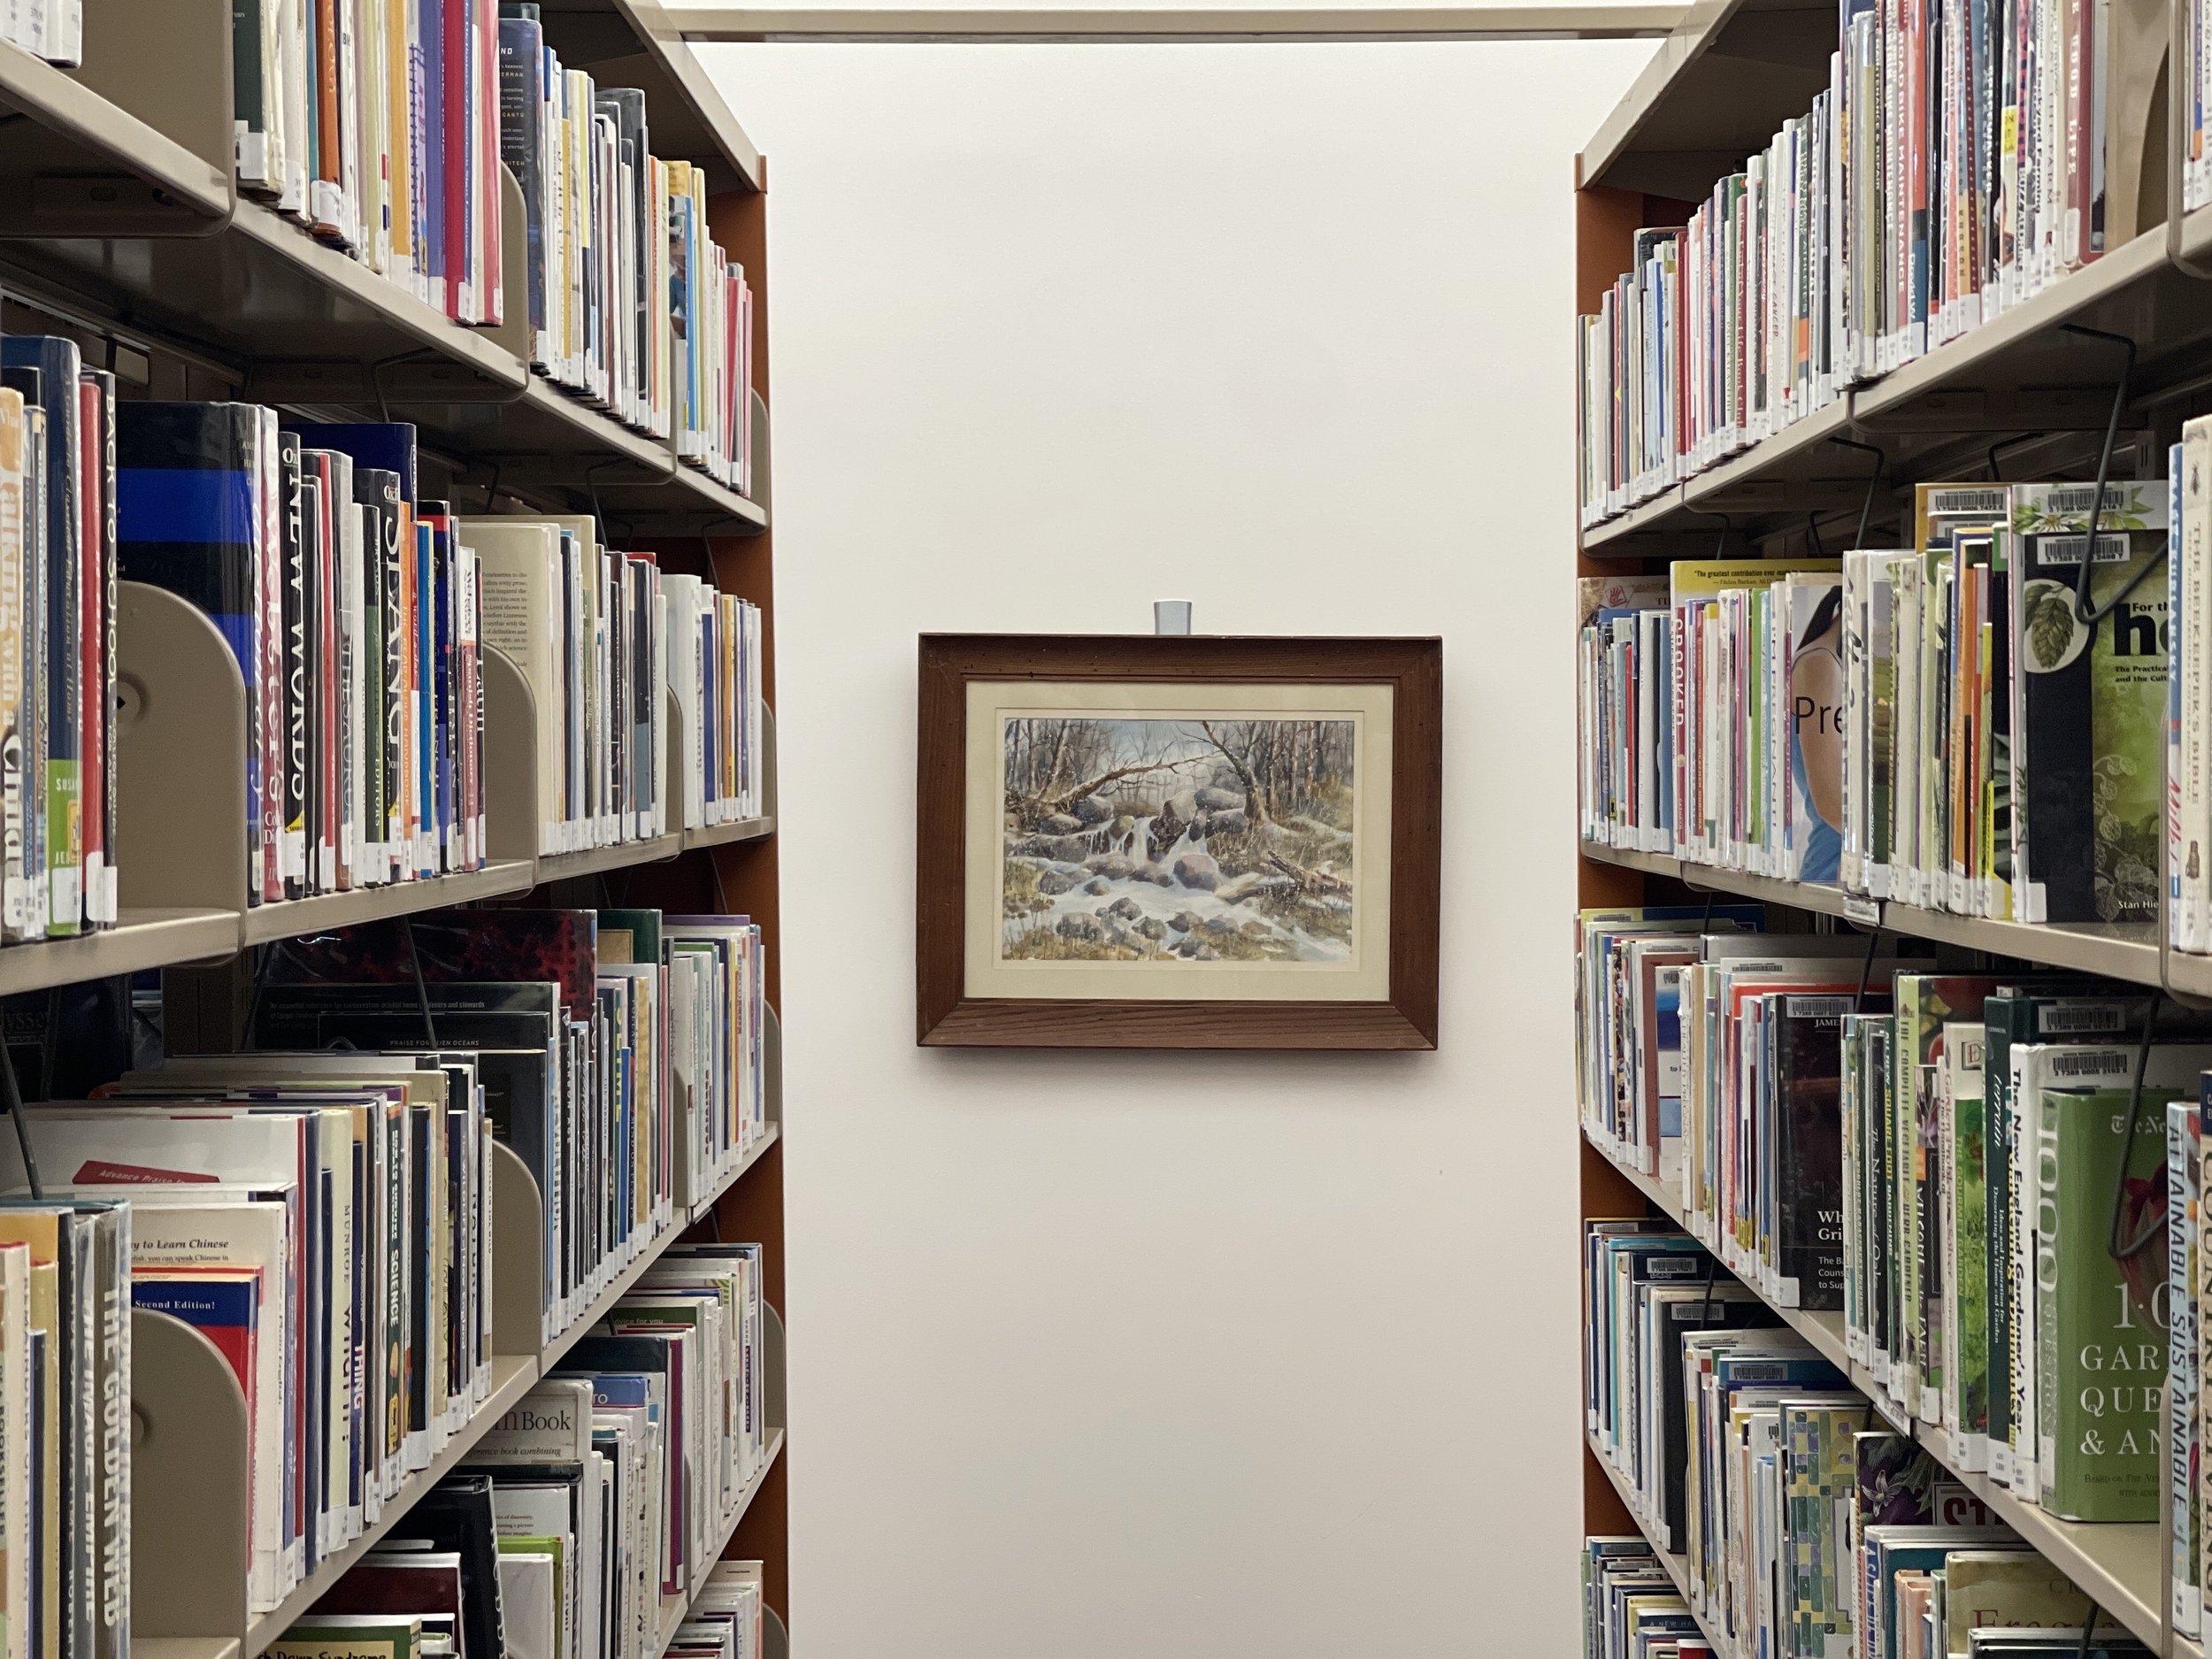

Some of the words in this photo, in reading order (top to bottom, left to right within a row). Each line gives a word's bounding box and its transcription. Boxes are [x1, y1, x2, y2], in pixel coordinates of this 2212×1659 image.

[106, 395, 115, 484] BACK
[107, 498, 115, 543] TO
[1708, 570, 1730, 579] greatest
[1731, 569, 1763, 578] contribution
[107, 557, 116, 693] SCHOOL
[384, 516, 403, 746] SLANG
[2132, 603, 2153, 612] For
[2169, 549, 2178, 683] KURLANSKY
[2192, 580, 2200, 733] BEEKEEPER'S
[291, 622, 304, 802] WORDS
[2118, 900, 2139, 910] Stan
[1814, 1018, 1841, 1028] JAME
[1901, 1048, 1909, 1111] COMPLETE
[2012, 1068, 2022, 1107] The
[1993, 1073, 2003, 1155] terrain
[2013, 1115, 2022, 1164] New
[98, 1168, 139, 1181] Advance
[1901, 1119, 1910, 1184] VEGETABLE
[1817, 1210, 1844, 1224] Wh
[1956, 1167, 1964, 1233] GOURMET
[2014, 1171, 2024, 1256] England
[2169, 1125, 2186, 1301] ATTAINABLE
[142, 1239, 154, 1248] to
[157, 1239, 186, 1249] Learn
[188, 1238, 229, 1248] Chinese
[1817, 1228, 1844, 1240] Gri
[390, 1248, 399, 1328] SCIENCE
[1903, 1240, 1912, 1302] GARDENER
[83, 1298, 94, 1362] THE
[104, 1288, 119, 1363] THE
[134, 1300, 171, 1310] Second
[174, 1301, 216, 1310] Edition!
[2015, 1262, 2025, 1379] Gardener's
[353, 1341, 364, 1410] THING
[2080, 1344, 2170, 1371] GAR
[83, 1368, 95, 1477] IMAGE
[521, 1409, 571, 1432] Book
[2016, 1386, 2025, 1435] Year
[2079, 1386, 2162, 1417] QUE
[2171, 1311, 2187, 1512] SUSTAINABLE
[104, 1371, 119, 1531] GOLDEN
[500, 1447, 518, 1456] book
[519, 1447, 562, 1457] combining
[2079, 1429, 2106, 1455] &
[85, 1492, 95, 1624] EMPIRE
[104, 1537, 119, 1627] WEB
